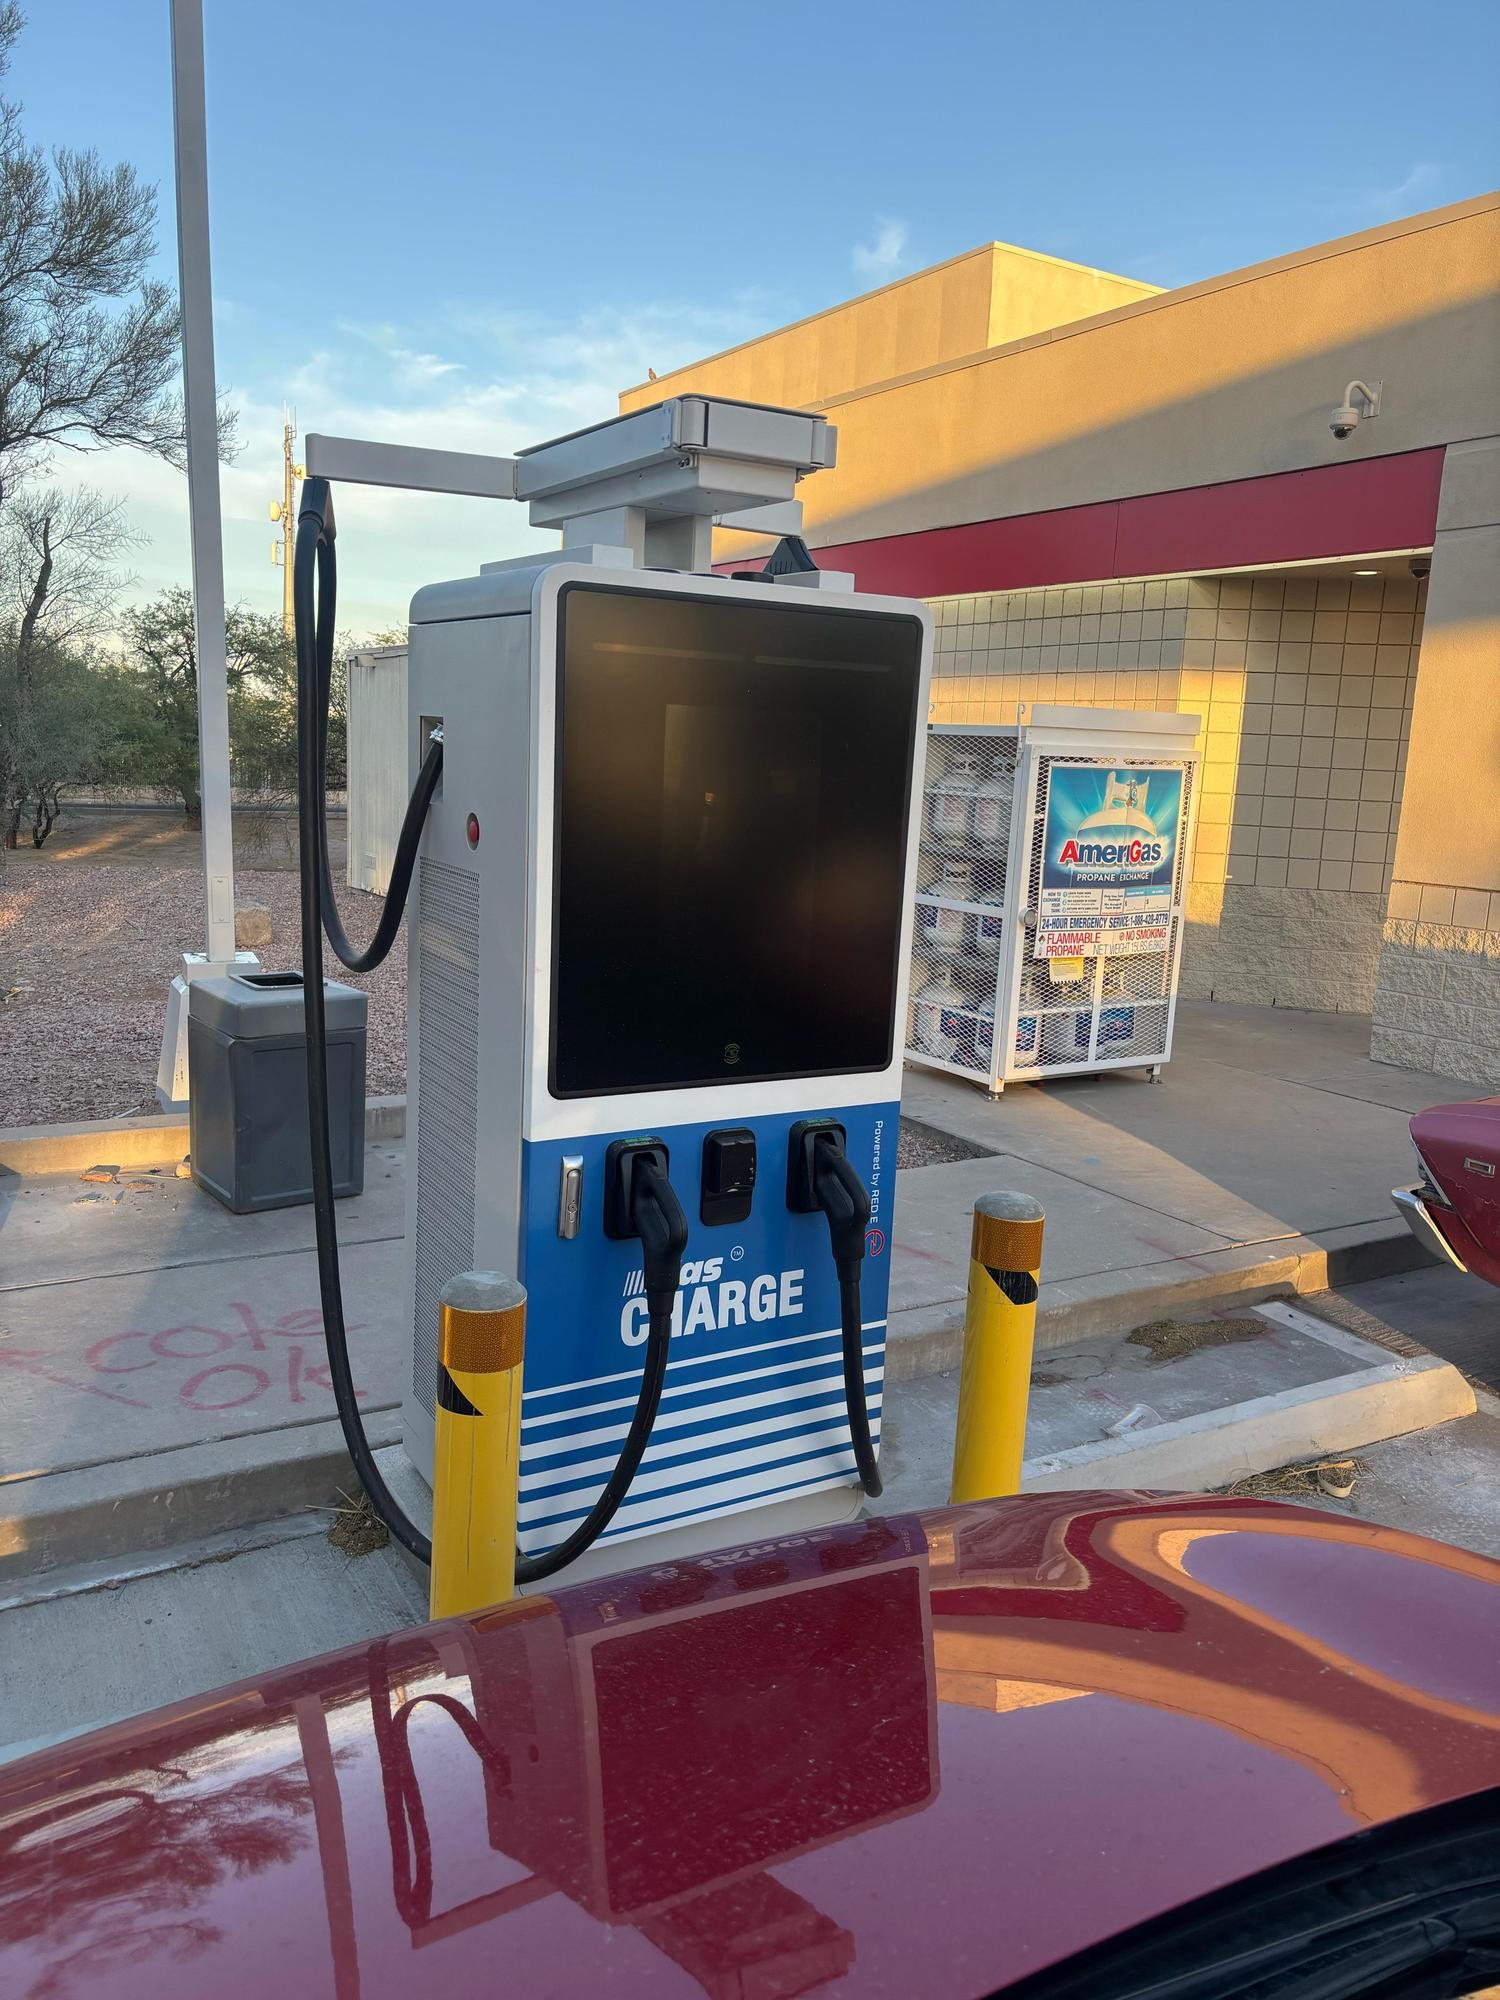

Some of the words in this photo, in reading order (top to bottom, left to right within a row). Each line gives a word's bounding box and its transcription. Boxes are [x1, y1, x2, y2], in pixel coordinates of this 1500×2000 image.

[1058, 839, 1162, 865] AmeriGas
[1076, 873, 1116, 882] PROPANE
[1119, 871, 1149, 882] EXCHANGE
[1041, 918, 1068, 930] 24-HOUR
[1069, 917, 1108, 929] EMERGENCY
[1046, 932, 1101, 945] FLAMMABLE
[1125, 930, 1135, 942] NO
[1136, 927, 1167, 941] SMOKING
[1046, 945, 1085, 957] PROPANE
[1092, 943, 1109, 956] NET
[1109, 942, 1131, 955] WEIGHT
[872, 1120, 884, 1171] Powered
[870, 1173, 881, 1187] by
